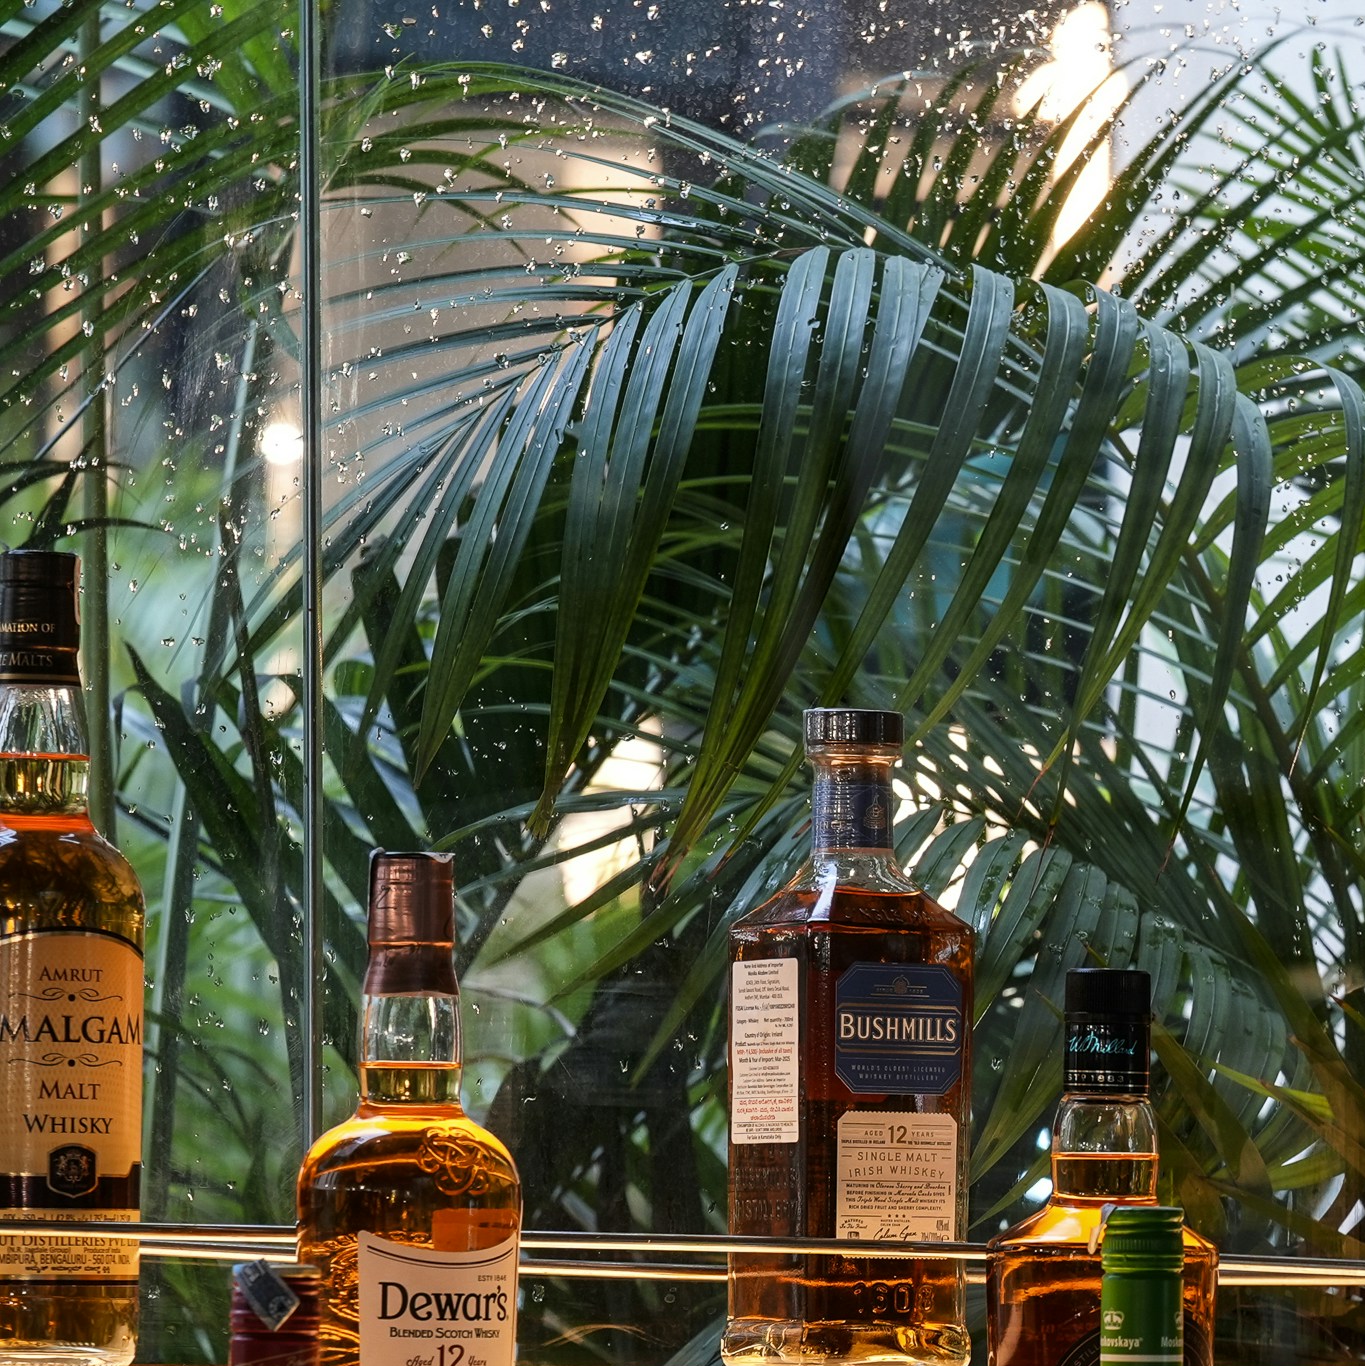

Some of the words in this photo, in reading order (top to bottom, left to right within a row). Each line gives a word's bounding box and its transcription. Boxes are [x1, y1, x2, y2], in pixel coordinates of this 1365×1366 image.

[9, 652, 54, 666] MALTS
[39, 966, 103, 982] AMRUT
[840, 1013, 956, 1041] BUSHMILLS
[858, 1072, 895, 1080] WHISKEY
[38, 1080, 100, 1100] MALT
[22, 1114, 113, 1134] WHISKY
[888, 1125, 907, 1144] 12
[857, 1152, 901, 1161] SINGLE
[906, 1153, 937, 1163] MALT
[849, 1166, 883, 1178] IRISH
[890, 1165, 945, 1179] WHISKEY
[41, 1254, 87, 1265] BENGALURU
[377, 1286, 508, 1321] Dewar's
[390, 1327, 434, 1338] BLENDED
[435, 1328, 473, 1339] SCOTCH
[475, 1328, 500, 1338] WHISKY
